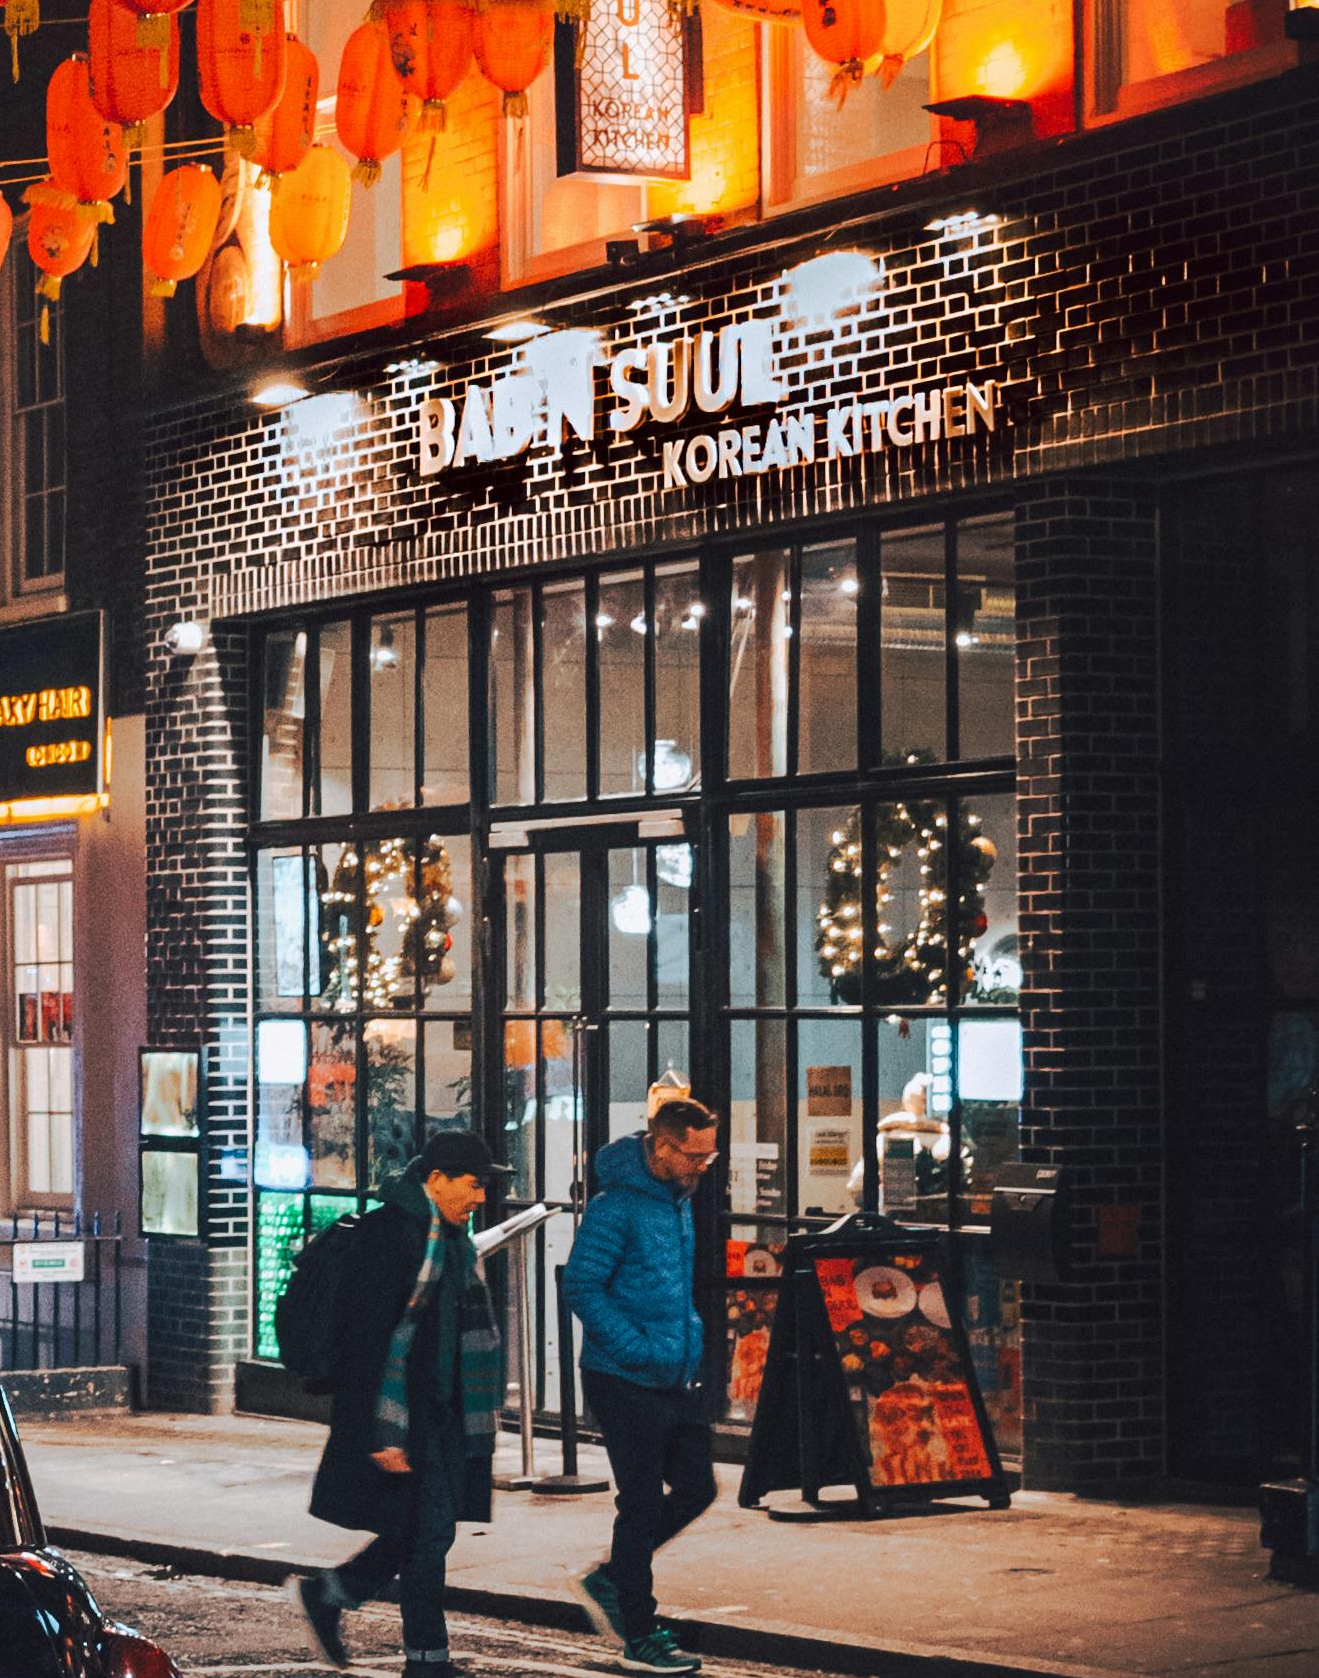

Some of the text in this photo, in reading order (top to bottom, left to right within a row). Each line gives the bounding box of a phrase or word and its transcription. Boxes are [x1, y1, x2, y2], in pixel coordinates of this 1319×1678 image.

[592, 98, 671, 122] KOREAN
[592, 128, 671, 150] KITCHEN
[663, 378, 997, 489] KOREAN KITCHEN
